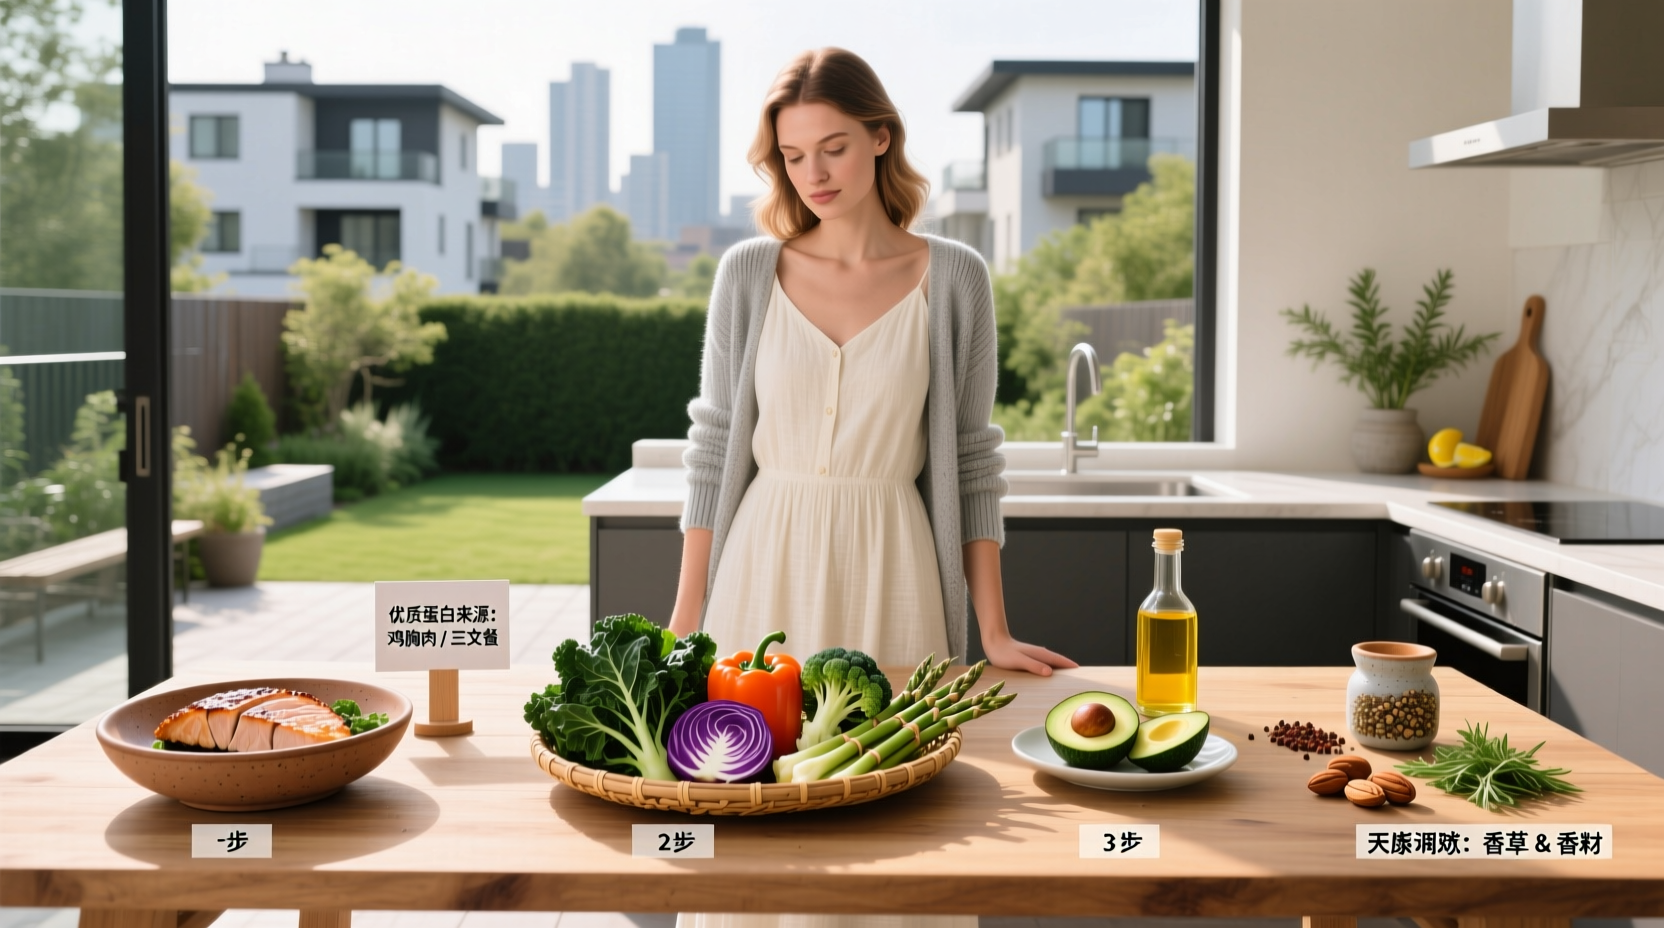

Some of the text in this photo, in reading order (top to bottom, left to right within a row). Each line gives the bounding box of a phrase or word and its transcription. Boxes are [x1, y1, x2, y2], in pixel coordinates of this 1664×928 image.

[387, 628, 437, 648] 鸡胸肉
[440, 630, 448, 648] /
[658, 831, 696, 853] 2步
[1103, 831, 1143, 854] 3步
[1482, 830, 1529, 856] 香草
[1534, 833, 1552, 853] &
